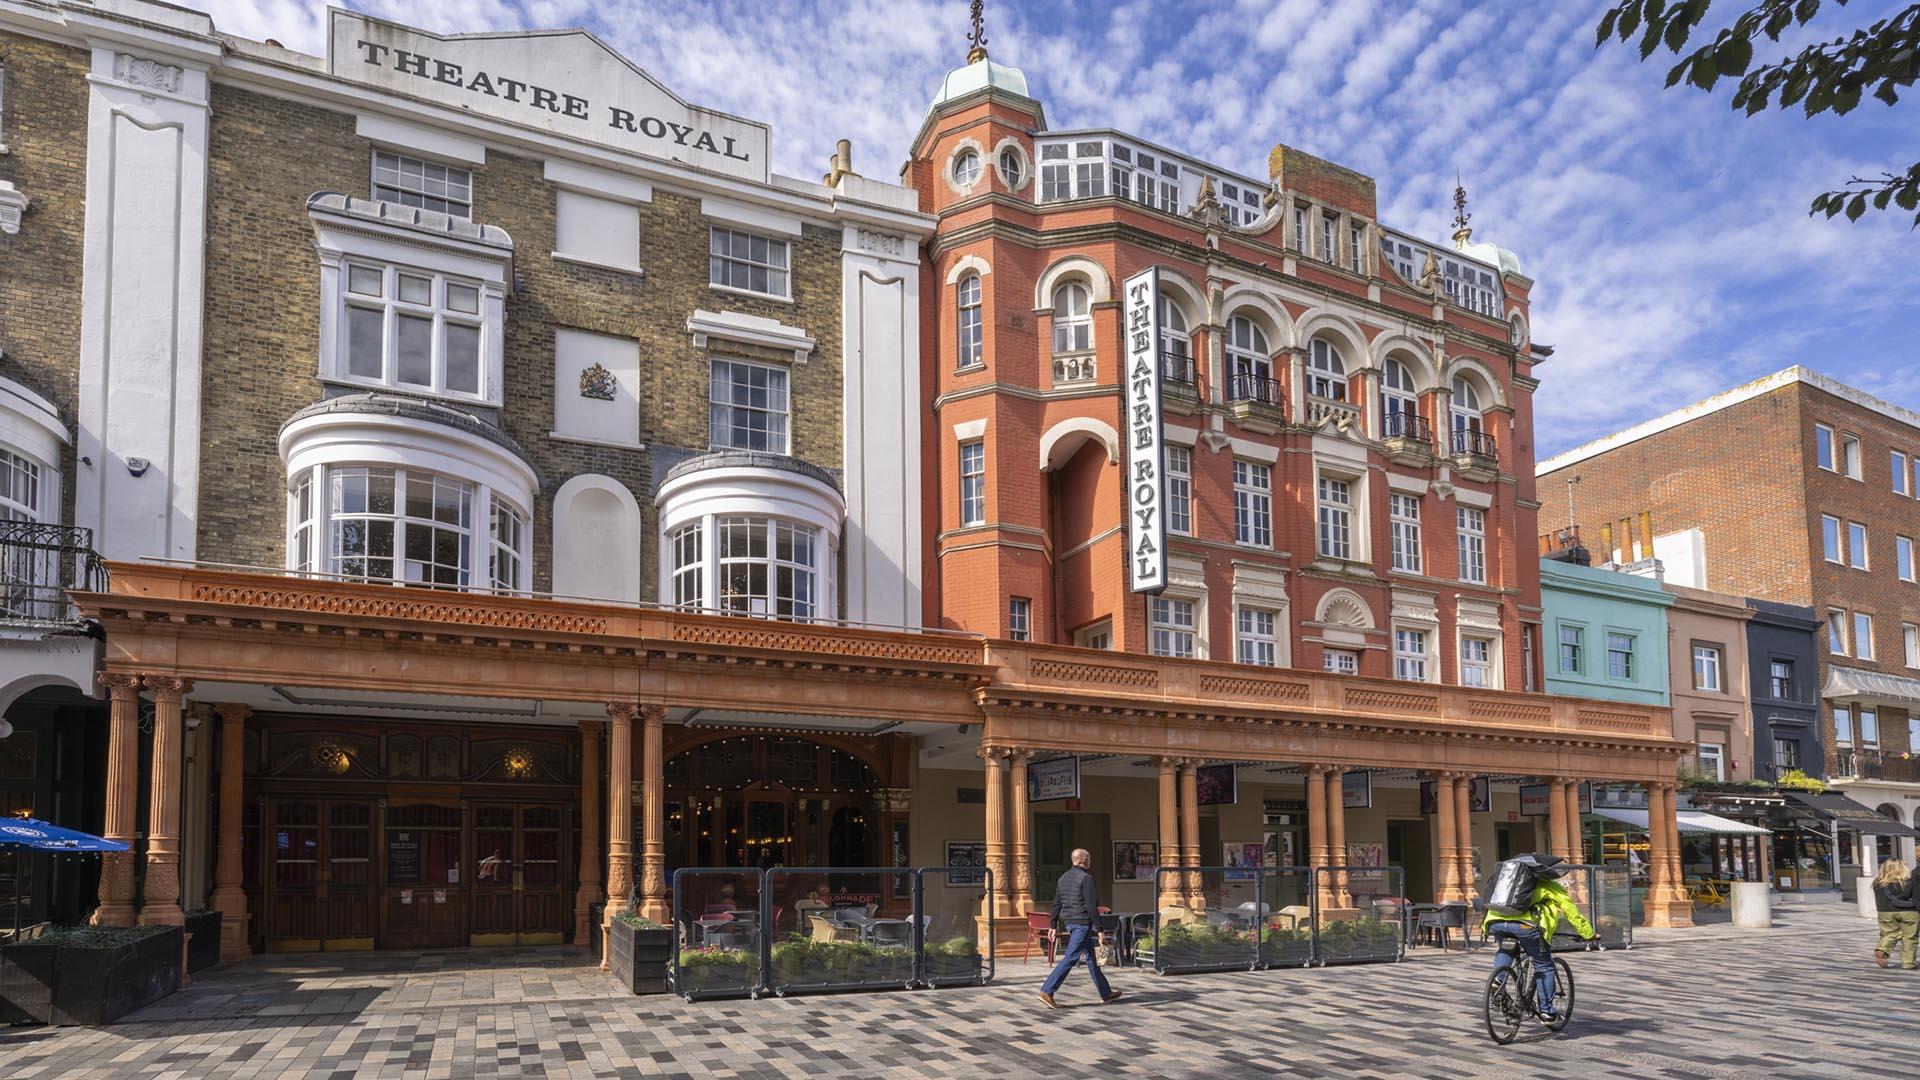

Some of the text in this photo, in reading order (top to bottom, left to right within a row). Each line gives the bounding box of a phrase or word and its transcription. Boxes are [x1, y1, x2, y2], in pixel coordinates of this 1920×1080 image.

[357, 40, 750, 162] THEATRE ROYAL
[1129, 281, 1158, 581] THEATRE ROYAL
